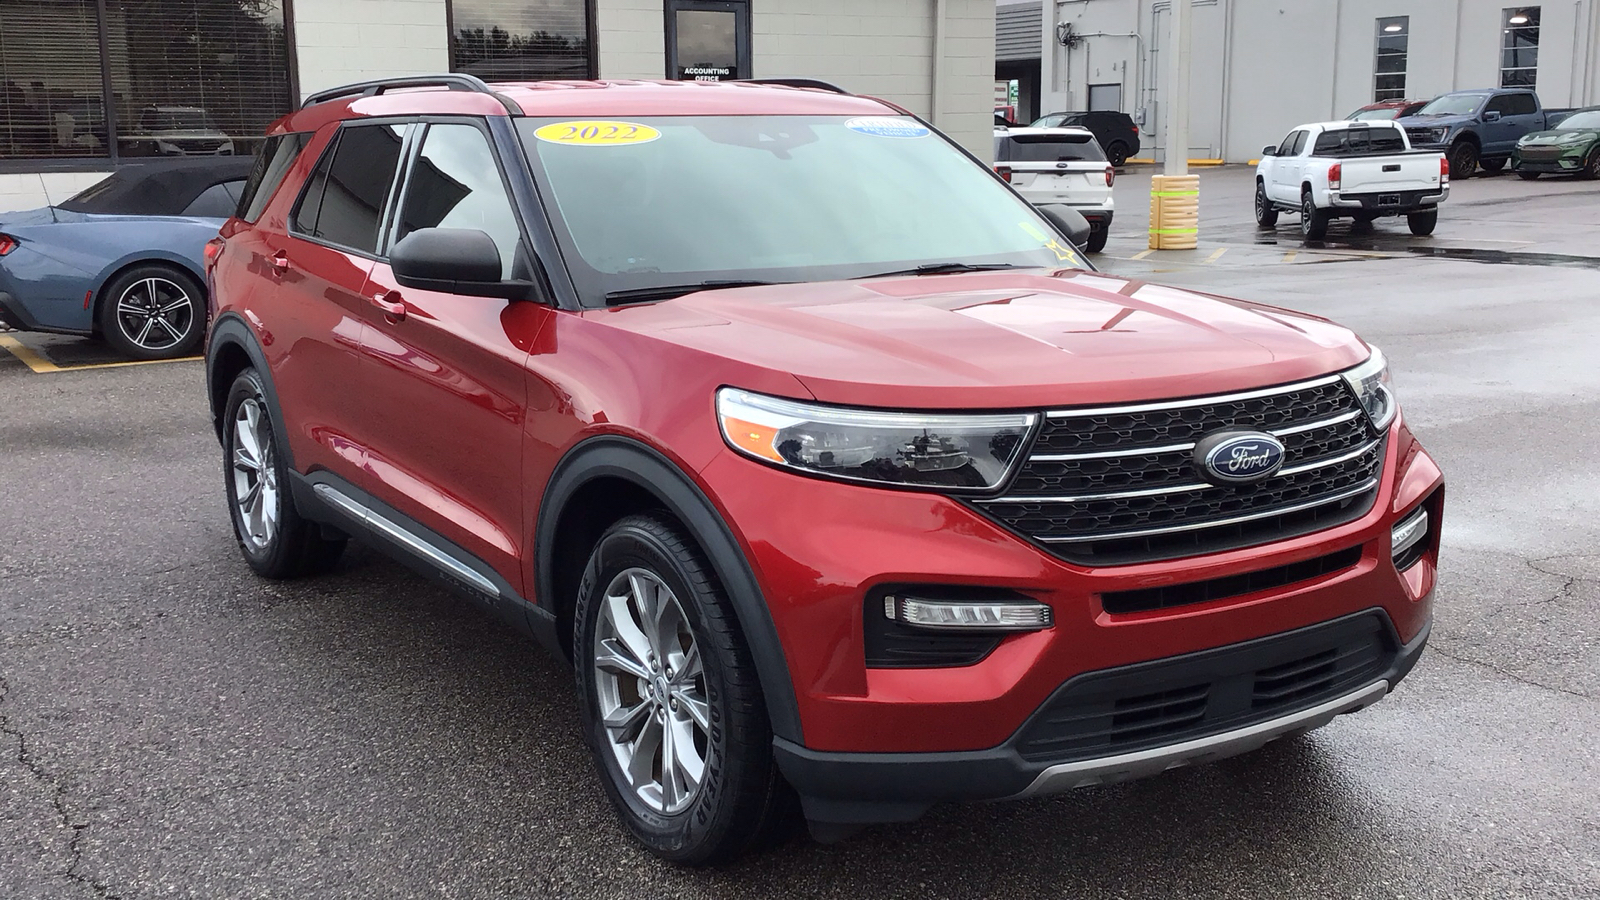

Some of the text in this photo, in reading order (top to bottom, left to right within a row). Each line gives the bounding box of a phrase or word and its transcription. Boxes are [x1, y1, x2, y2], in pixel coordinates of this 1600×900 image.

[684, 67, 730, 75] ACCOUNTING
[560, 125, 638, 140] 2022
[1228, 444, 1270, 472] Ford
